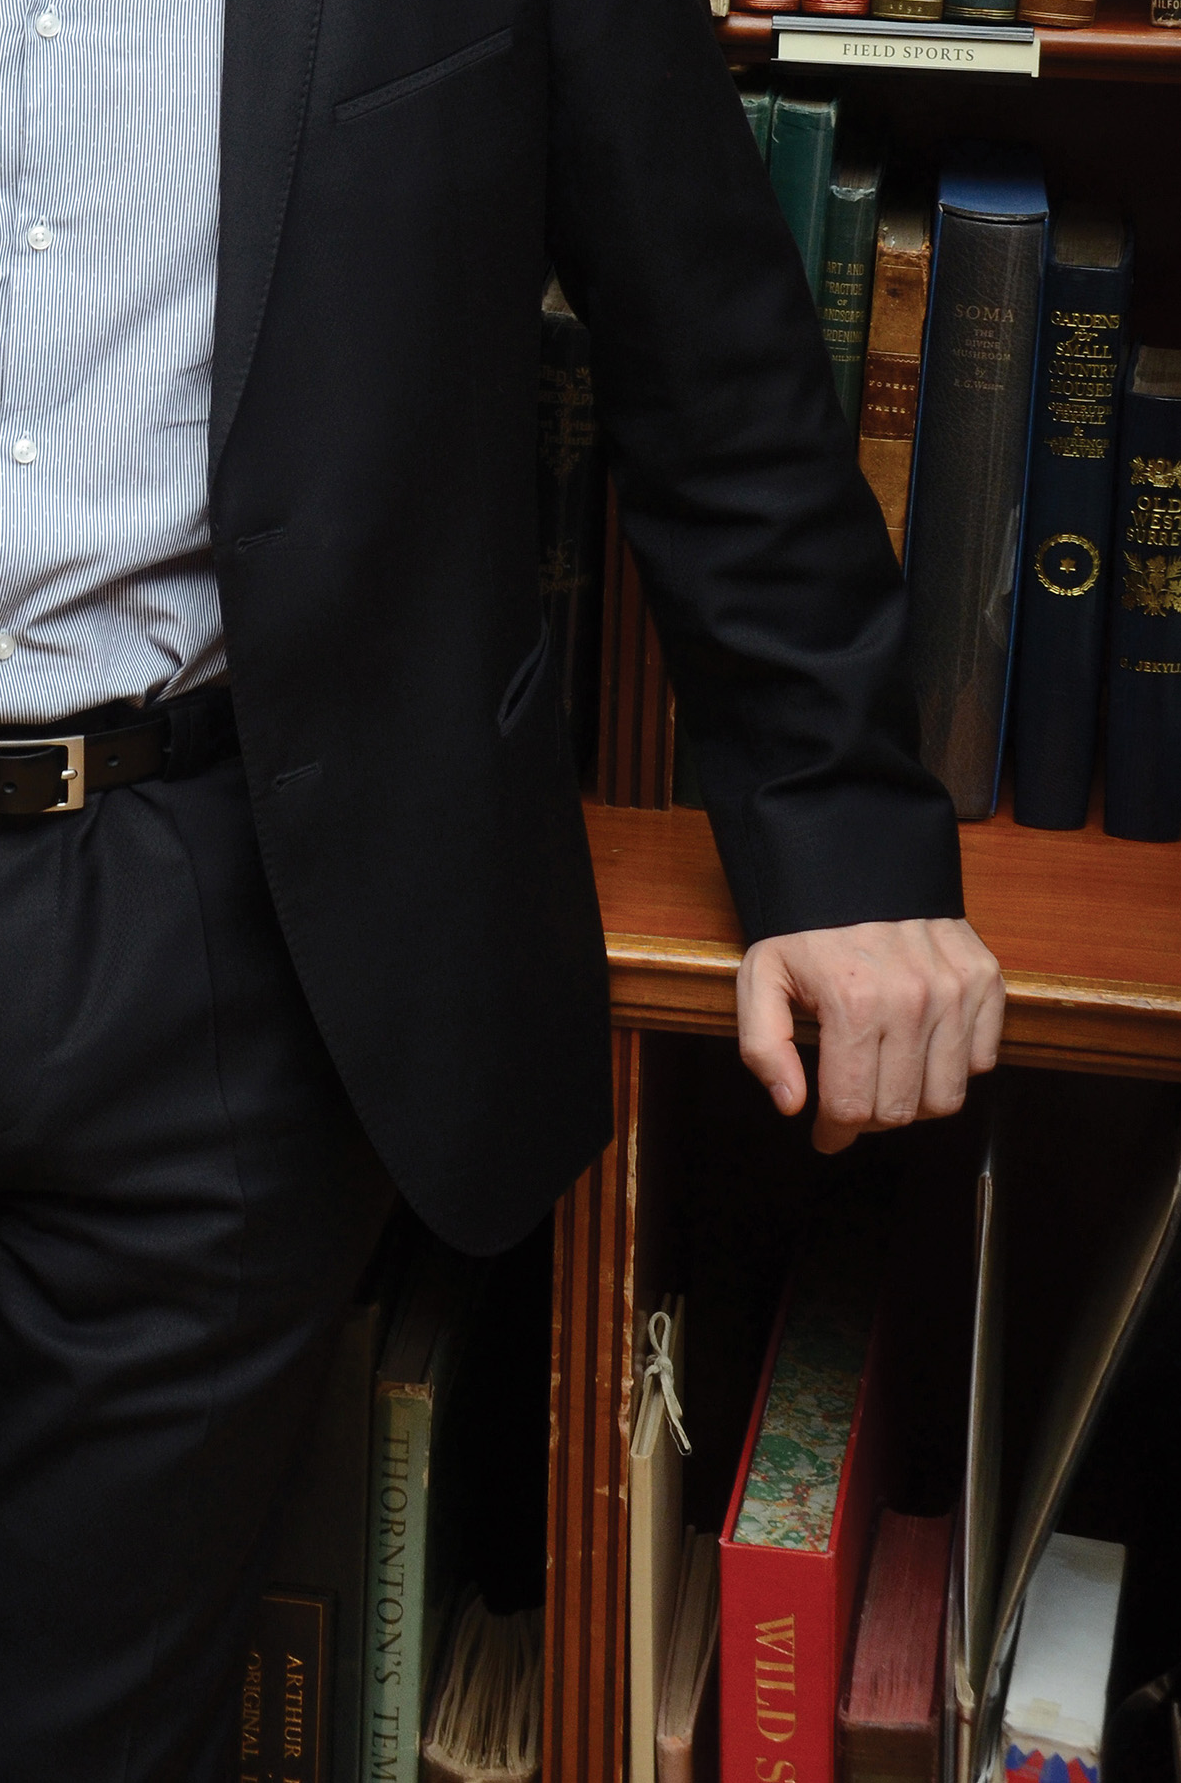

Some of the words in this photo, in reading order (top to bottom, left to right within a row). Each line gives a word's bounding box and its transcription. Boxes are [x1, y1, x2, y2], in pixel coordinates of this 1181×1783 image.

[842, 42, 895, 60] FIELD
[902, 44, 975, 62] SPORTS
[955, 304, 1014, 322] SOMA
[1051, 311, 1120, 328] GARDENS
[966, 340, 1000, 348] DIVINE
[1056, 342, 1112, 358] SMALL
[1049, 360, 1117, 377] COUNTRY
[1050, 378, 1112, 397] HOUSES
[376, 1430, 410, 1686] THORNTON'S
[755, 1613, 796, 1742] WILD
[284, 1653, 304, 1759] ARTHUR
